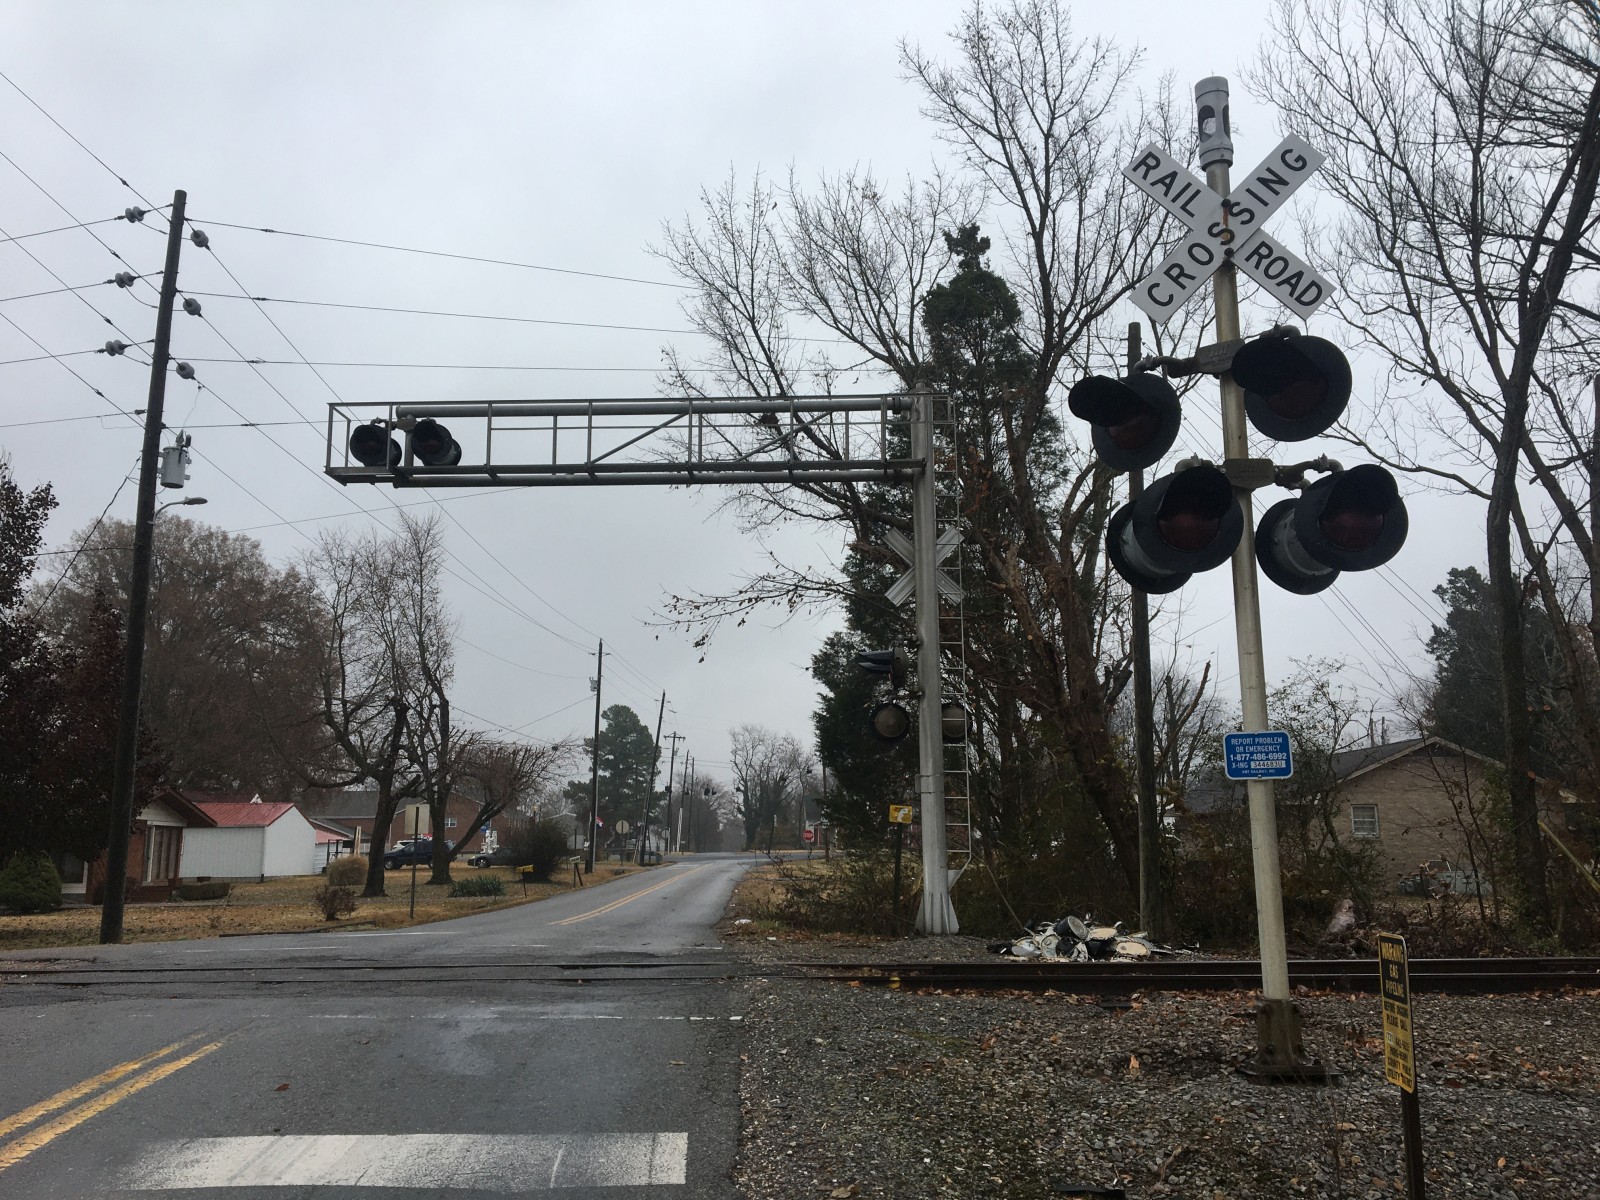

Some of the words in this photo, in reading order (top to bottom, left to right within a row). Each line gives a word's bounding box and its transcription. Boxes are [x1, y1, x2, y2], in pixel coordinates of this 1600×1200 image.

[1131, 150, 1202, 219] RAIL
[1147, 148, 1308, 307] CROSSING
[1244, 240, 1323, 307] ROAD
[1230, 752, 1287, 761] 1-877-486-6992
[1381, 942, 1404, 964] WARNING
[1389, 963, 1399, 980] GAS
[1385, 979, 1405, 998] PIPELINE
